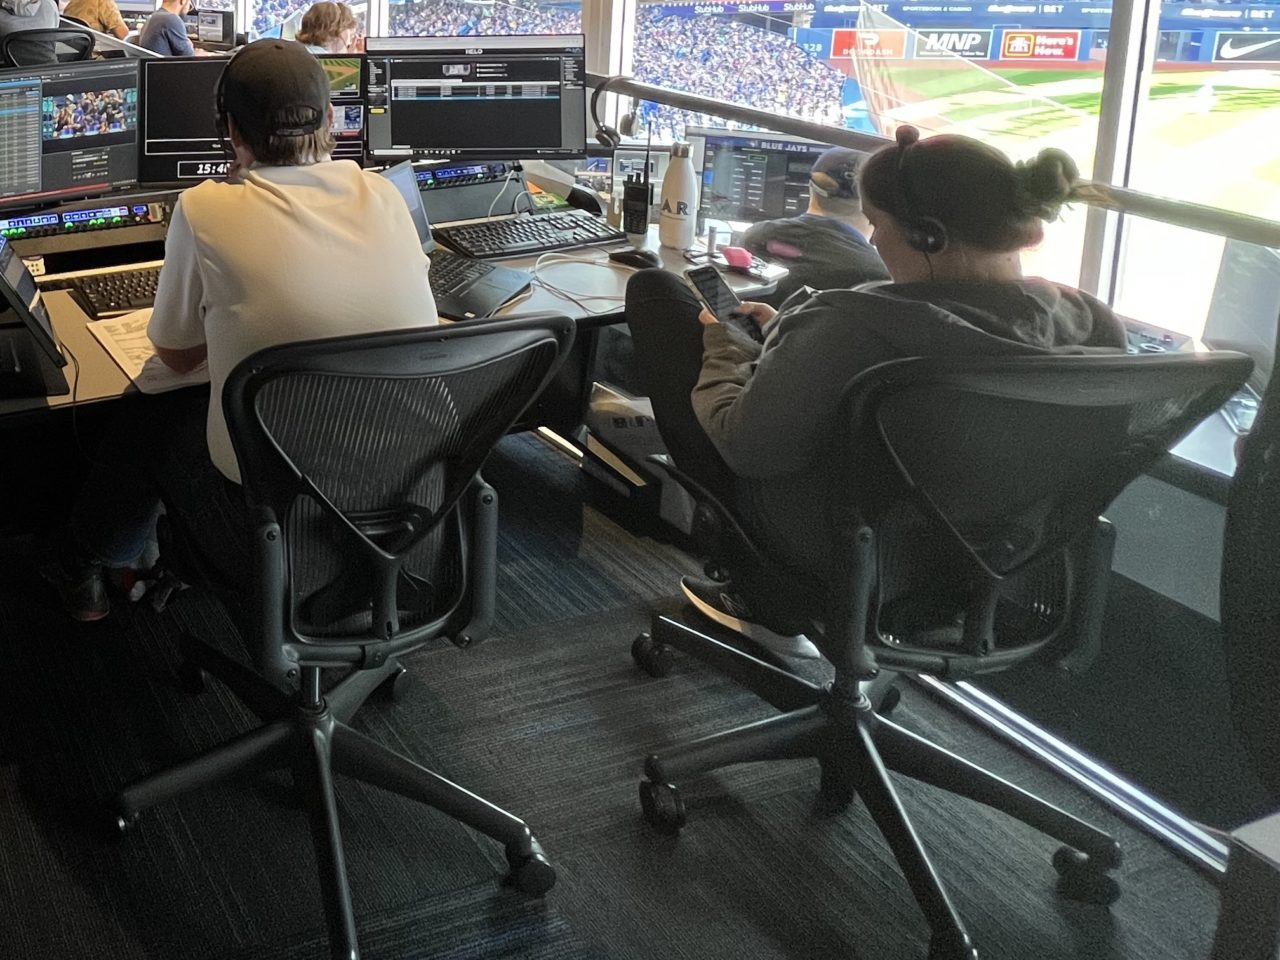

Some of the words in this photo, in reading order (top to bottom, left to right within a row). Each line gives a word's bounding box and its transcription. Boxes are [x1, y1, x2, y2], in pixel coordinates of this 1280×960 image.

[694, 4, 724, 14] StubHub
[738, 3, 770, 13] StubHub
[783, 3, 815, 12] StubHub
[1043, 5, 1065, 14] BET
[1250, 9, 1275, 19] BET
[925, 32, 982, 50] MNP
[1035, 35, 1074, 46] Here's
[1034, 46, 1065, 56] How.
[761, 141, 783, 151] BLUE
[785, 143, 808, 153] JAYS
